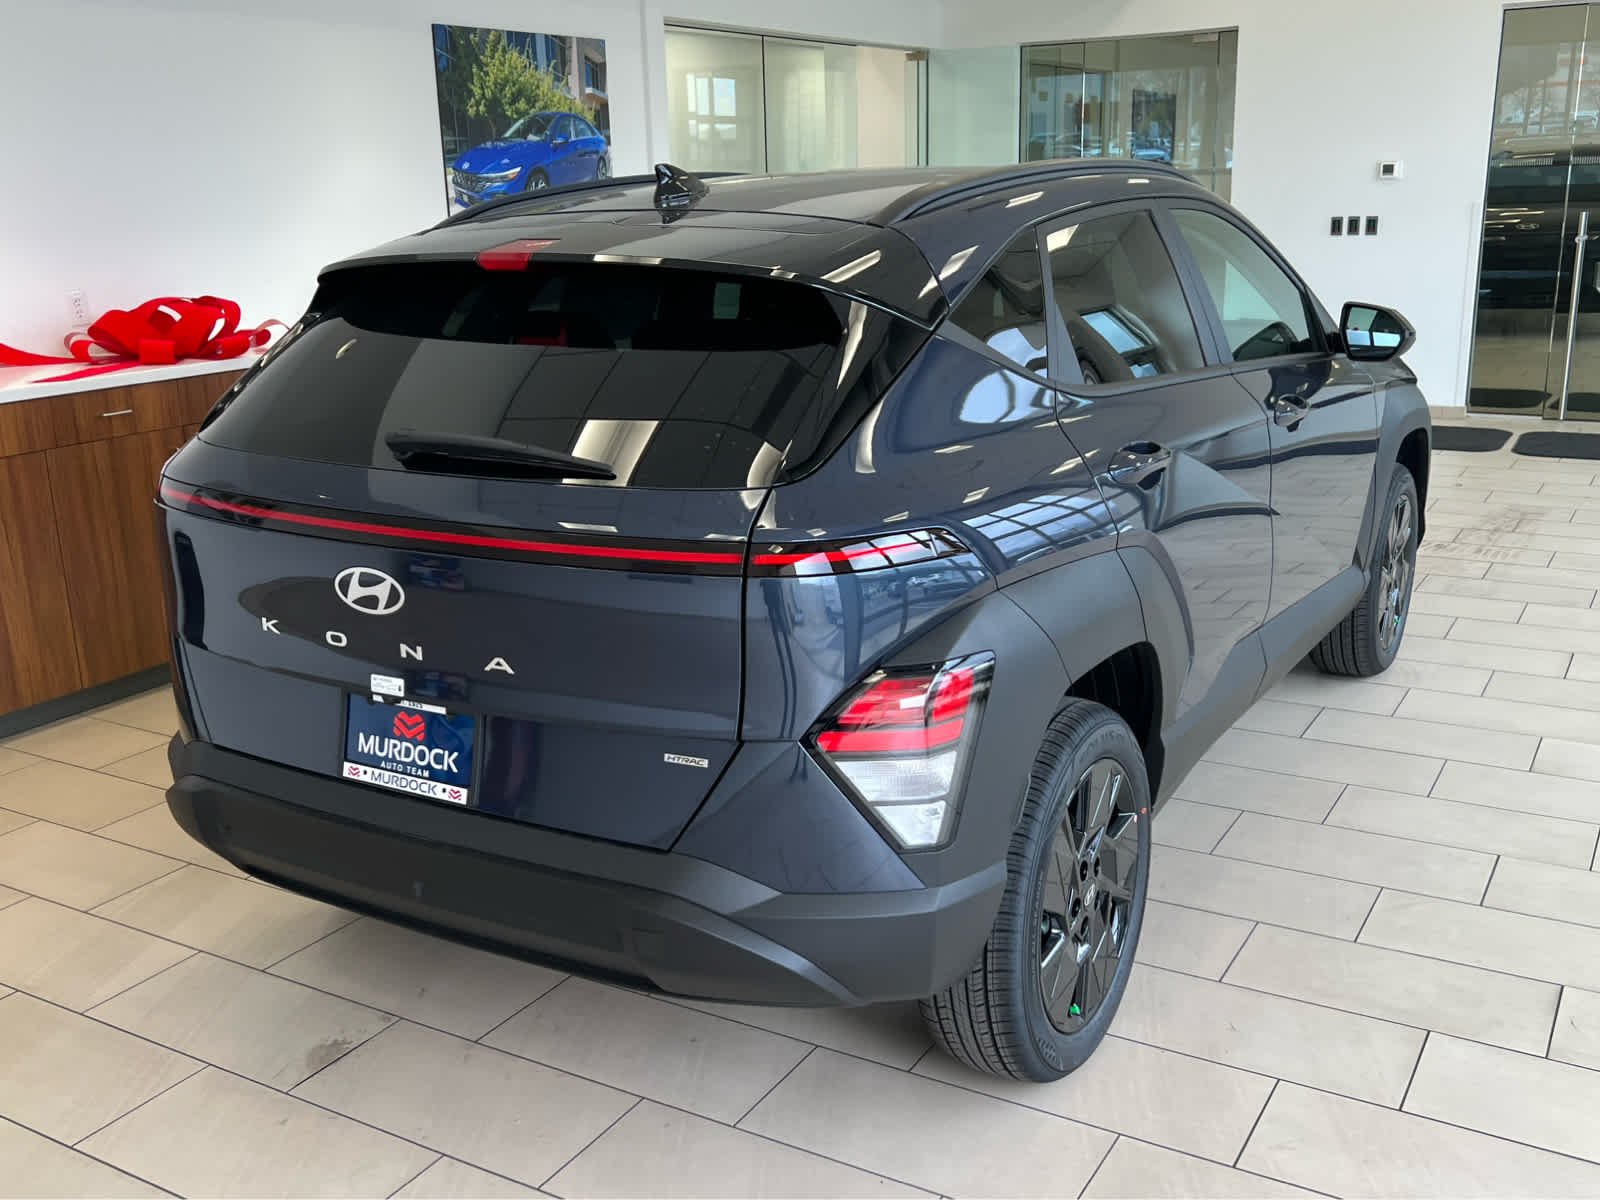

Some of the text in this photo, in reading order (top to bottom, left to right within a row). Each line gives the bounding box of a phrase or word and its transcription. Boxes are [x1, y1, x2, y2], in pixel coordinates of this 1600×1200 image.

[261, 616, 515, 675] KONA
[358, 732, 459, 773] MURDOCK
[665, 755, 706, 766] HTRAC
[380, 760, 430, 778] AUTO TEAM
[370, 770, 438, 796] MURDOCK
